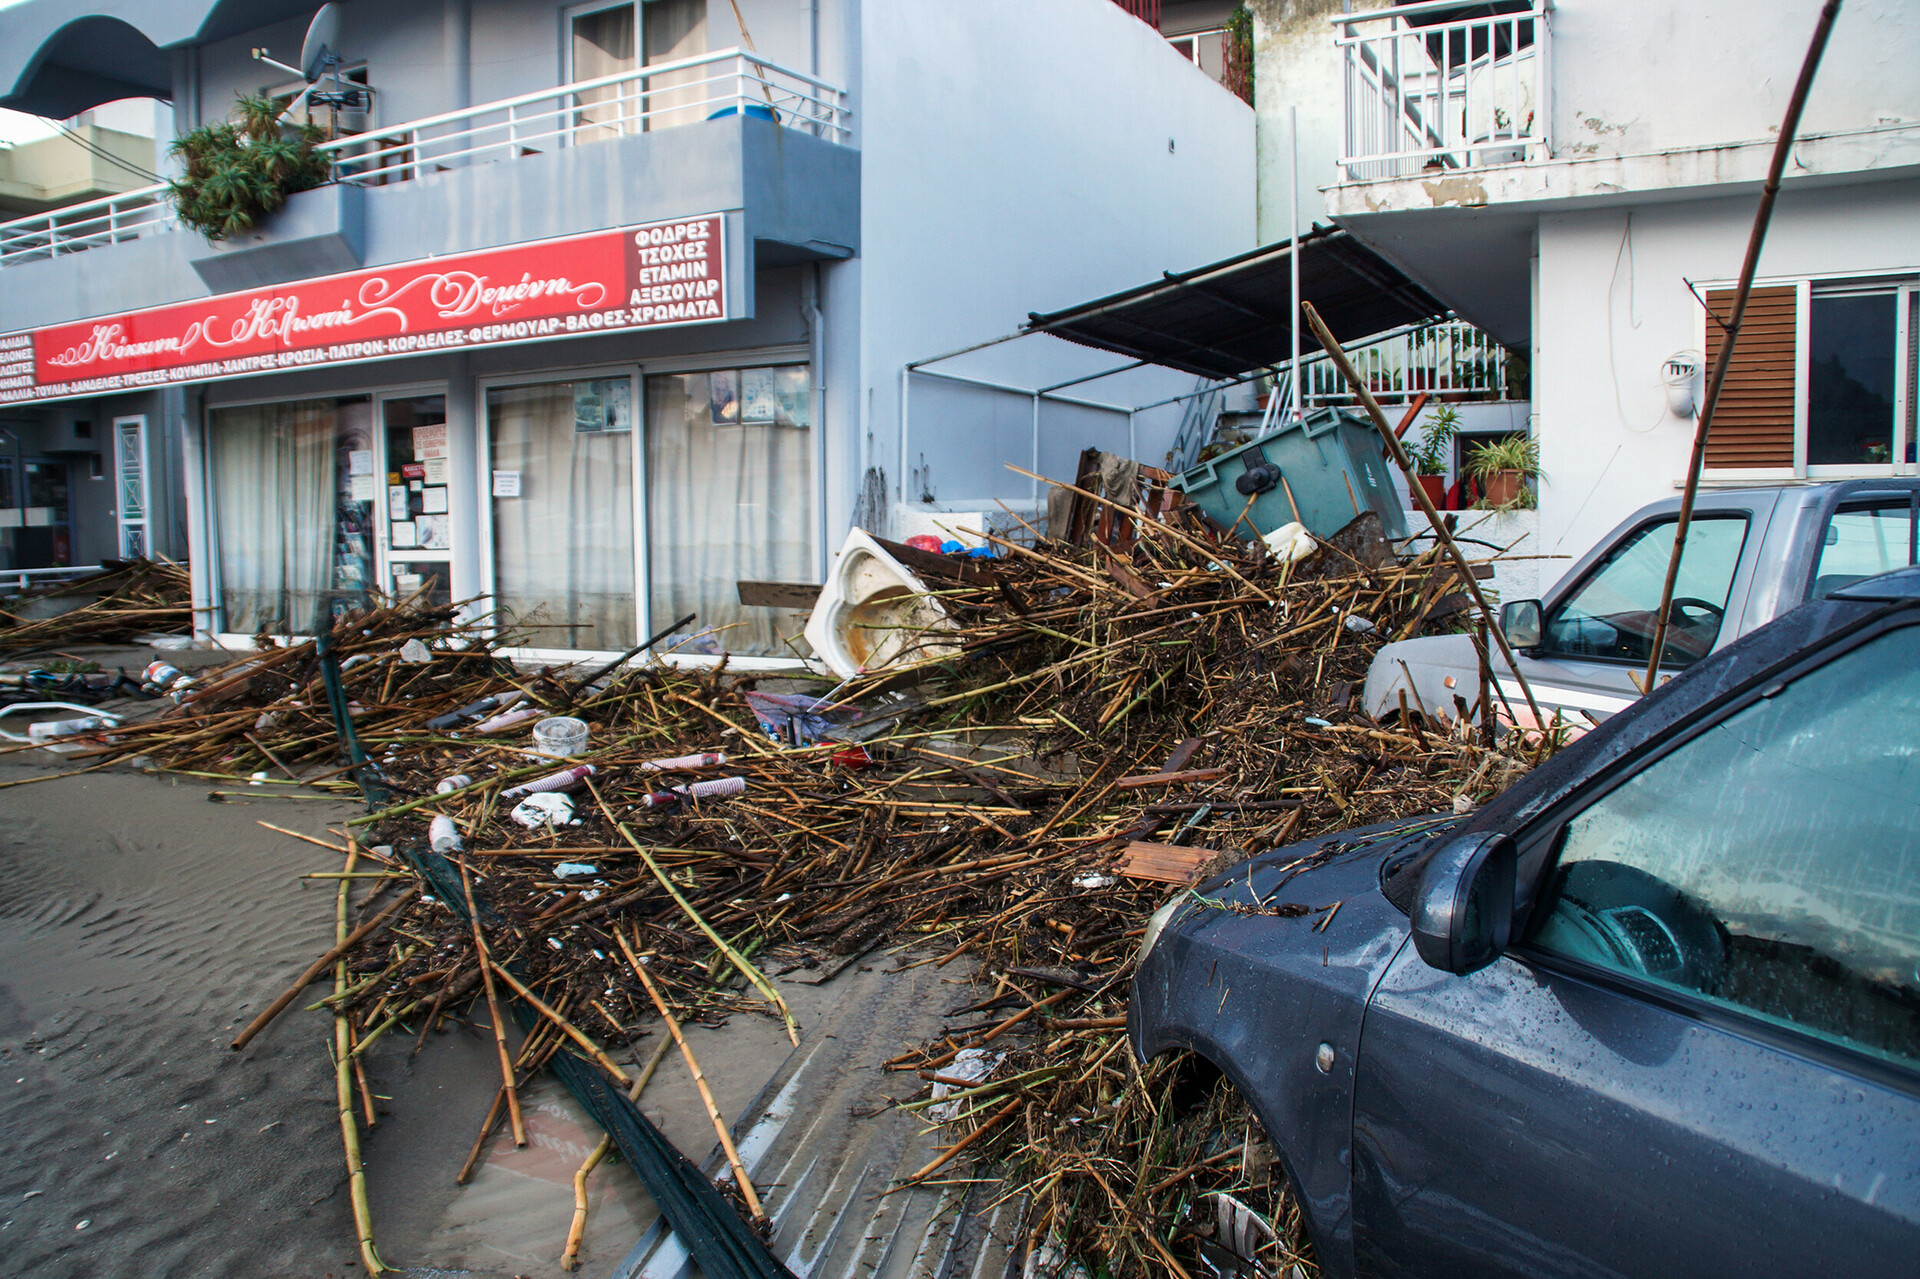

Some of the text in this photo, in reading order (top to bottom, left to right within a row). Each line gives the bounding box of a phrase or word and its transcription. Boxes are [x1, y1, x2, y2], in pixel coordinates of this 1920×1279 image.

[635, 220, 710, 247] ΦΟΔΡΕΣ
[638, 240, 708, 265] ΤΣΟΧΕΣ
[639, 260, 708, 284] ΕΤΑΜΙΝ
[630, 279, 719, 305] ΑΞΕΣΟΥΑΡ
[0, 335, 30, 349] ΑΛΙΔΙΑ
[0, 348, 33, 362] ΕΛΟΝΕΣ
[0, 361, 34, 376] ΛΩΣΤΕΣ
